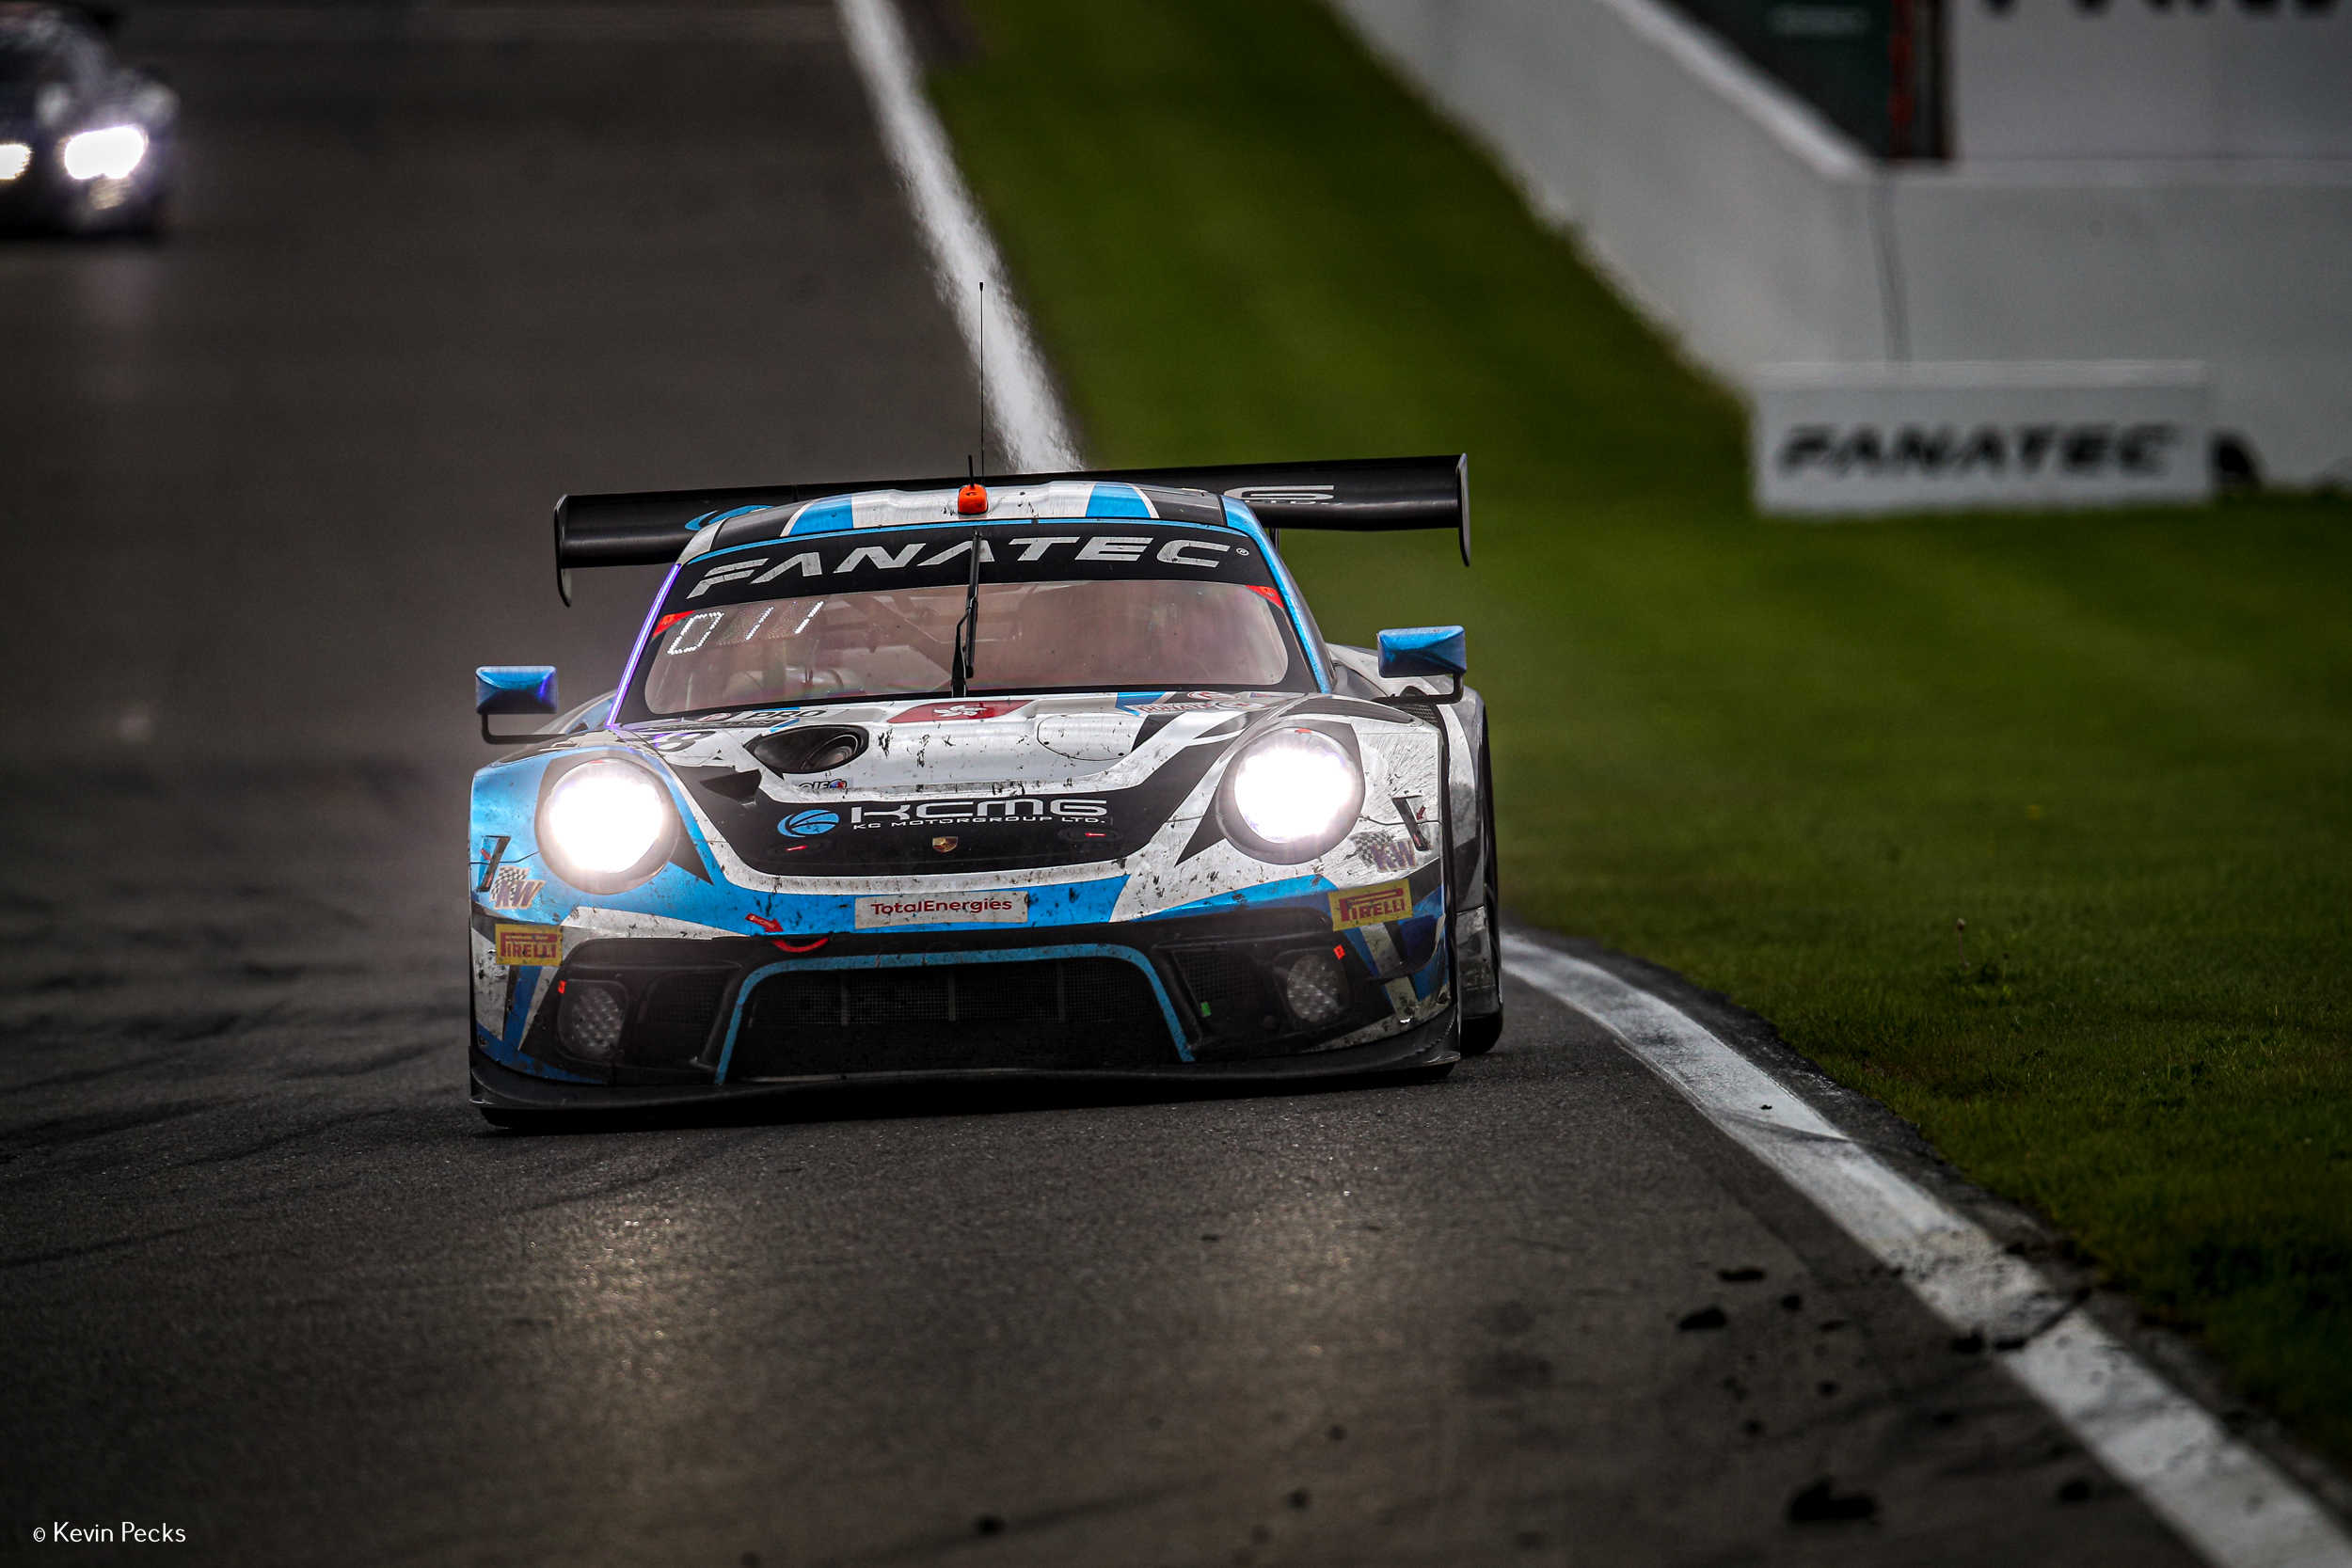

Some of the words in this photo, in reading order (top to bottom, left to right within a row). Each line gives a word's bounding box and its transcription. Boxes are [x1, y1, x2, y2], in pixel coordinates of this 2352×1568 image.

[1778, 421, 2177, 478] FANATEC
[850, 798, 1107, 824] KCMG
[891, 816, 1053, 828] MOTORGROUP
[1061, 816, 1106, 824] LTD.
[870, 897, 1013, 915] TotalEnergies
[1339, 887, 1406, 923] PIRELLI
[500, 931, 559, 958] PIRELLI
